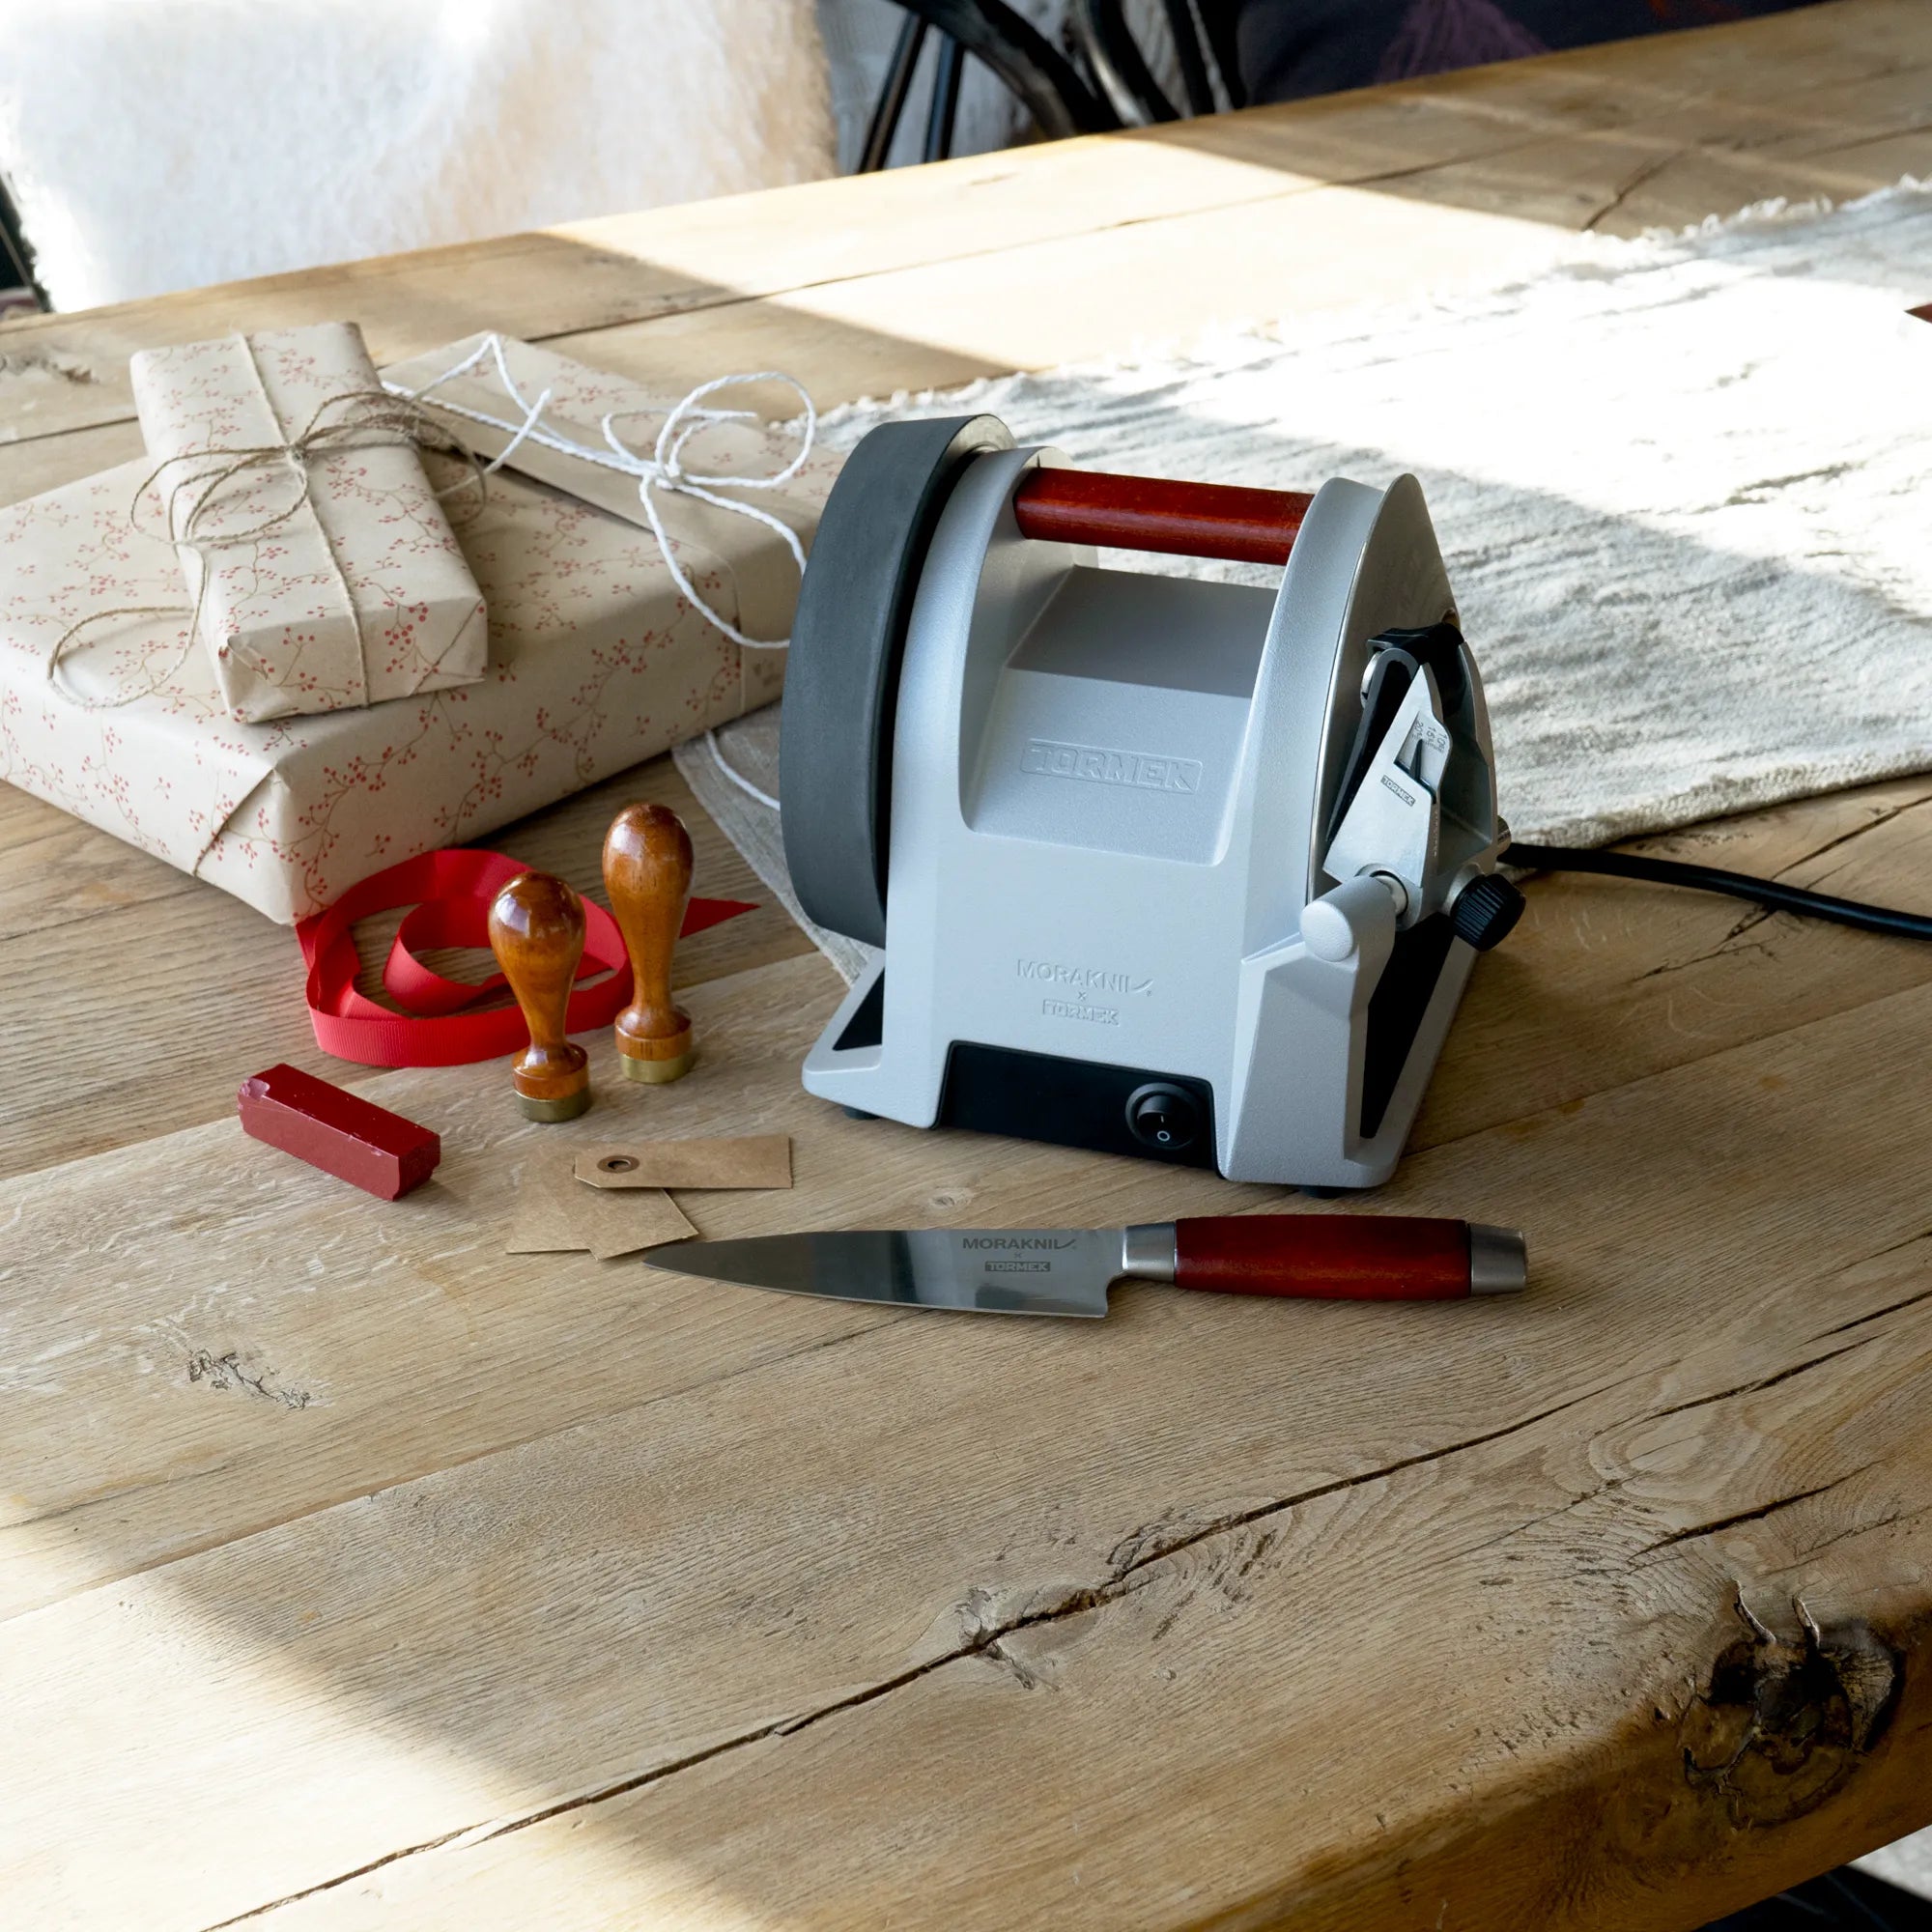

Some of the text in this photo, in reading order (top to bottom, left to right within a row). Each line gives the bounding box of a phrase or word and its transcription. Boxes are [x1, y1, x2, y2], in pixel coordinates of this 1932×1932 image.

[1027, 743, 1197, 792] TORMEK
[1381, 776, 1415, 807] TORMEK
[1043, 1000, 1121, 1027] TORMEK
[985, 1262, 1050, 1272] TORMEK
